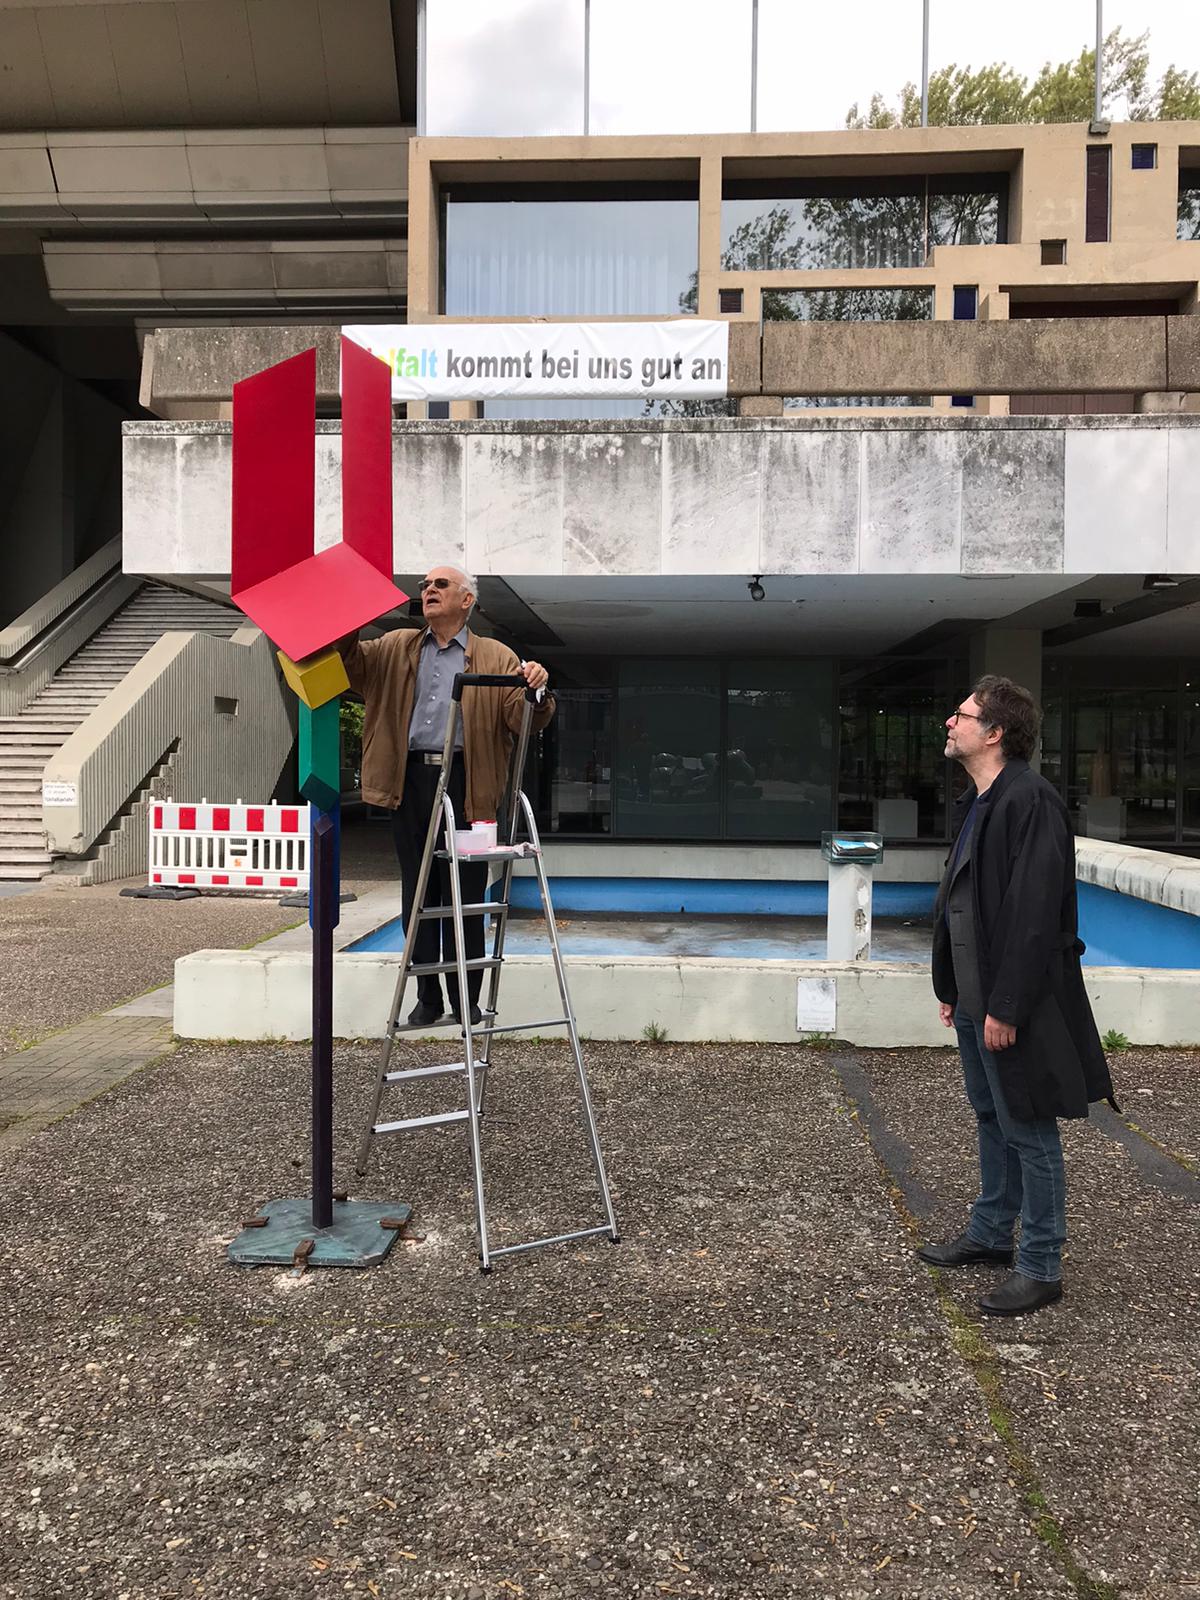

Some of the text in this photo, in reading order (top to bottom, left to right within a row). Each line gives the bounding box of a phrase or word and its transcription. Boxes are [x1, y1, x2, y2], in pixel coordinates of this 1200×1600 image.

[367, 348, 722, 387] lfalt kommt bei uns gut an
